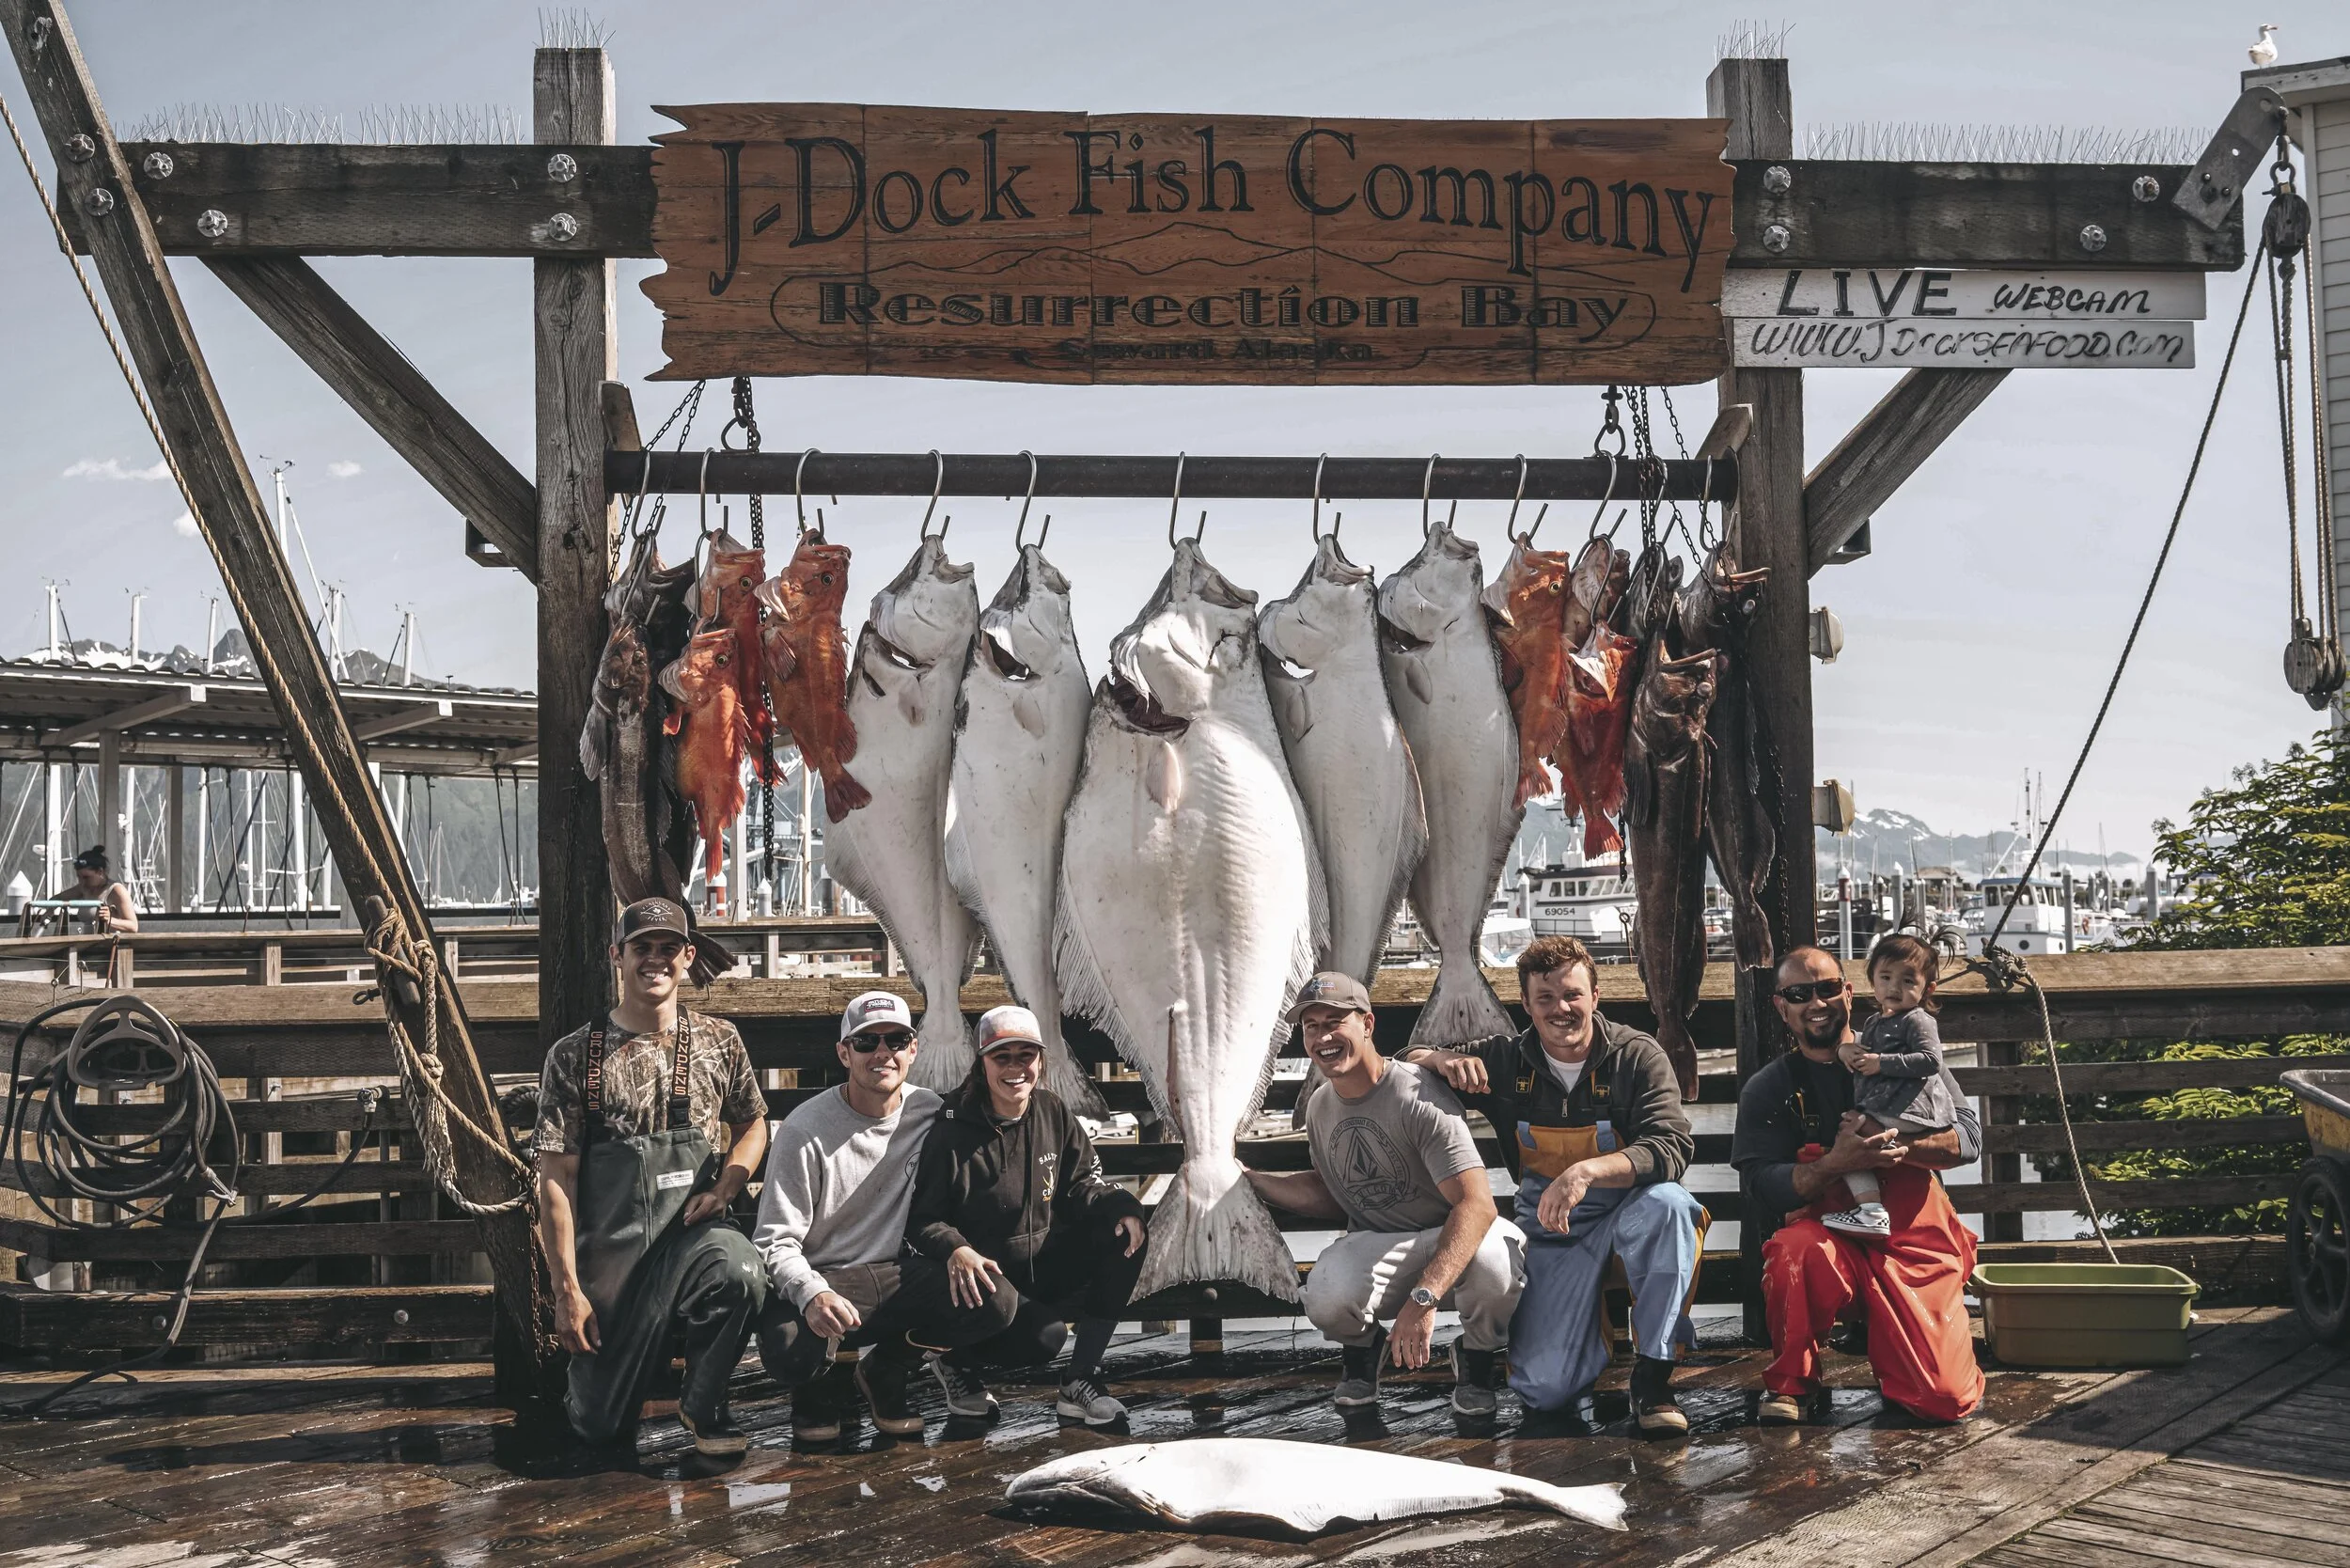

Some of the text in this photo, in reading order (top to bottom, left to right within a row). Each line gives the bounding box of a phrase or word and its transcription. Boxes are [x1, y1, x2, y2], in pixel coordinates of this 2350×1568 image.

[709, 125, 1714, 296] J-Dock Fish Company
[819, 282, 1628, 344] Resurrection Bay
[1778, 270, 2152, 317] LIVE WEBCAM
[1544, 907, 1575, 916] 69054
